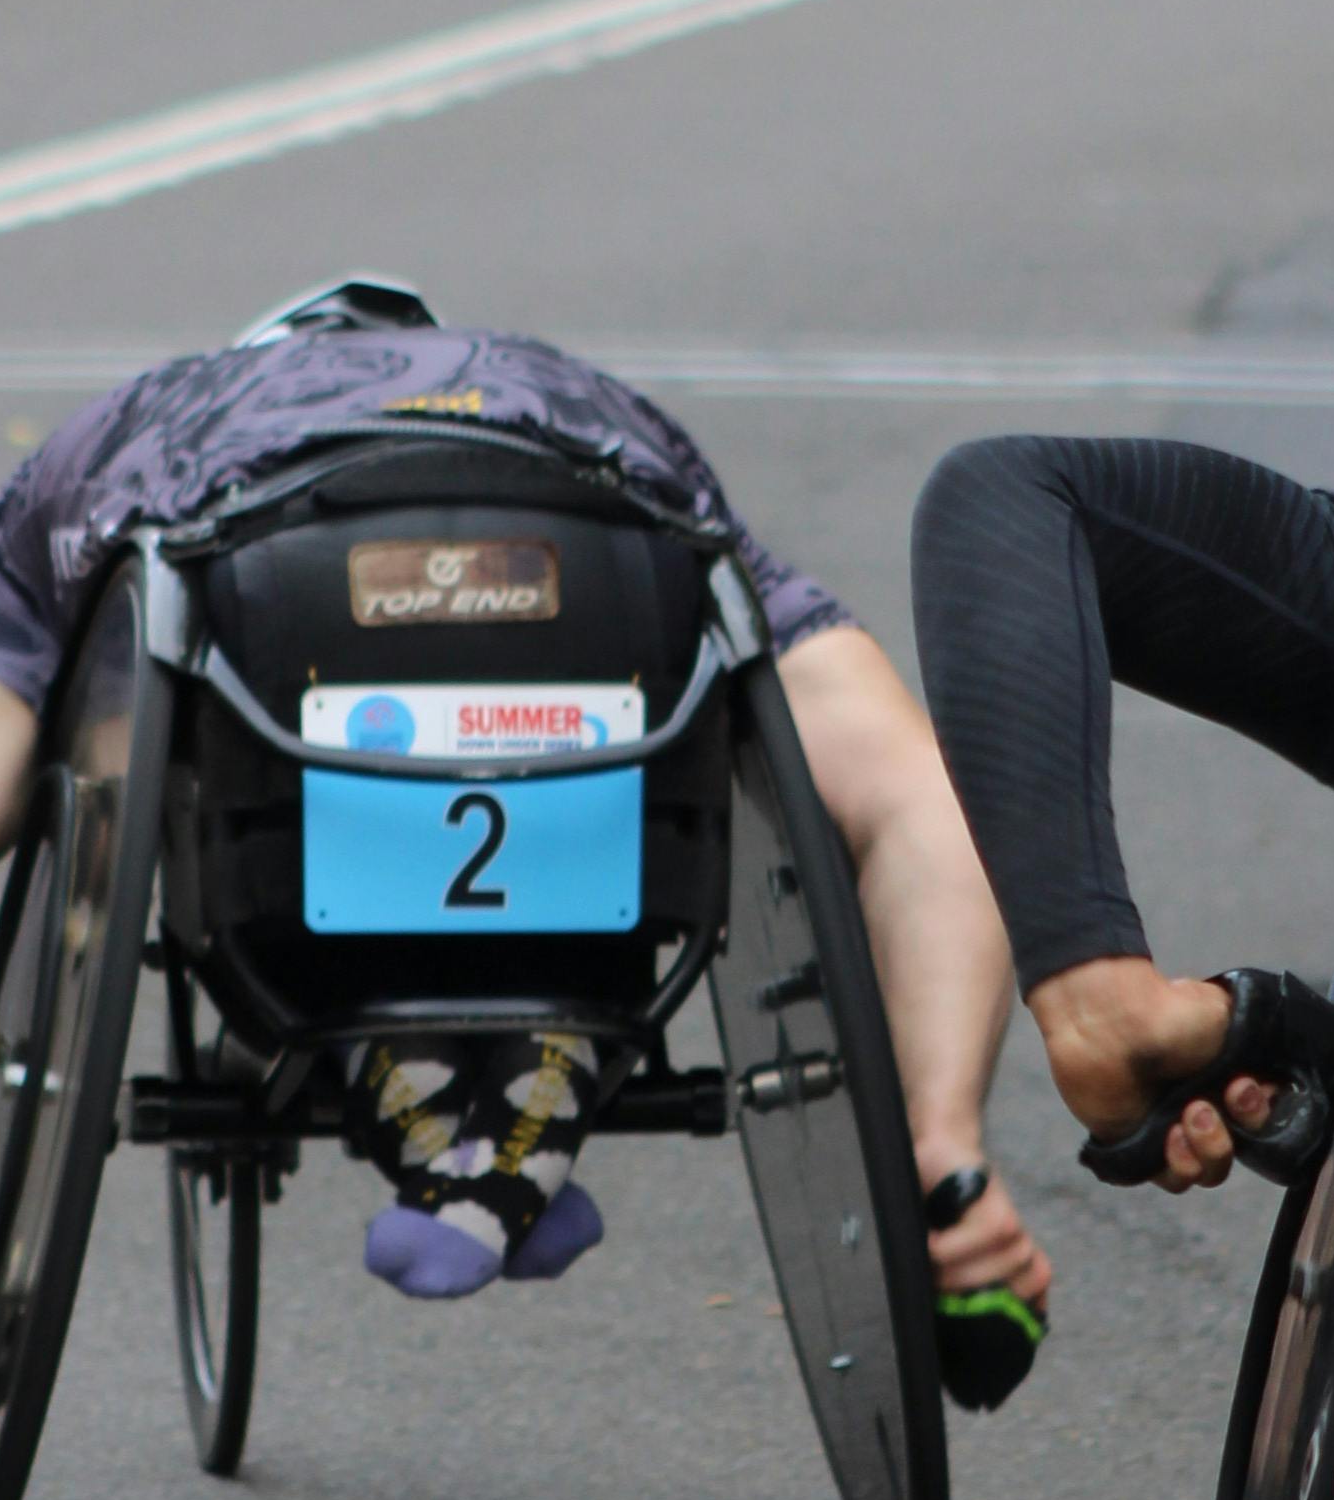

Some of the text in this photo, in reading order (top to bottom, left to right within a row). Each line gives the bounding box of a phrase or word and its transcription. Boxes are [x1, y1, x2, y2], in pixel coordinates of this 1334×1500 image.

[363, 586, 540, 618] TOP END
[458, 703, 583, 737] SUMMER
[443, 791, 507, 909] 2
